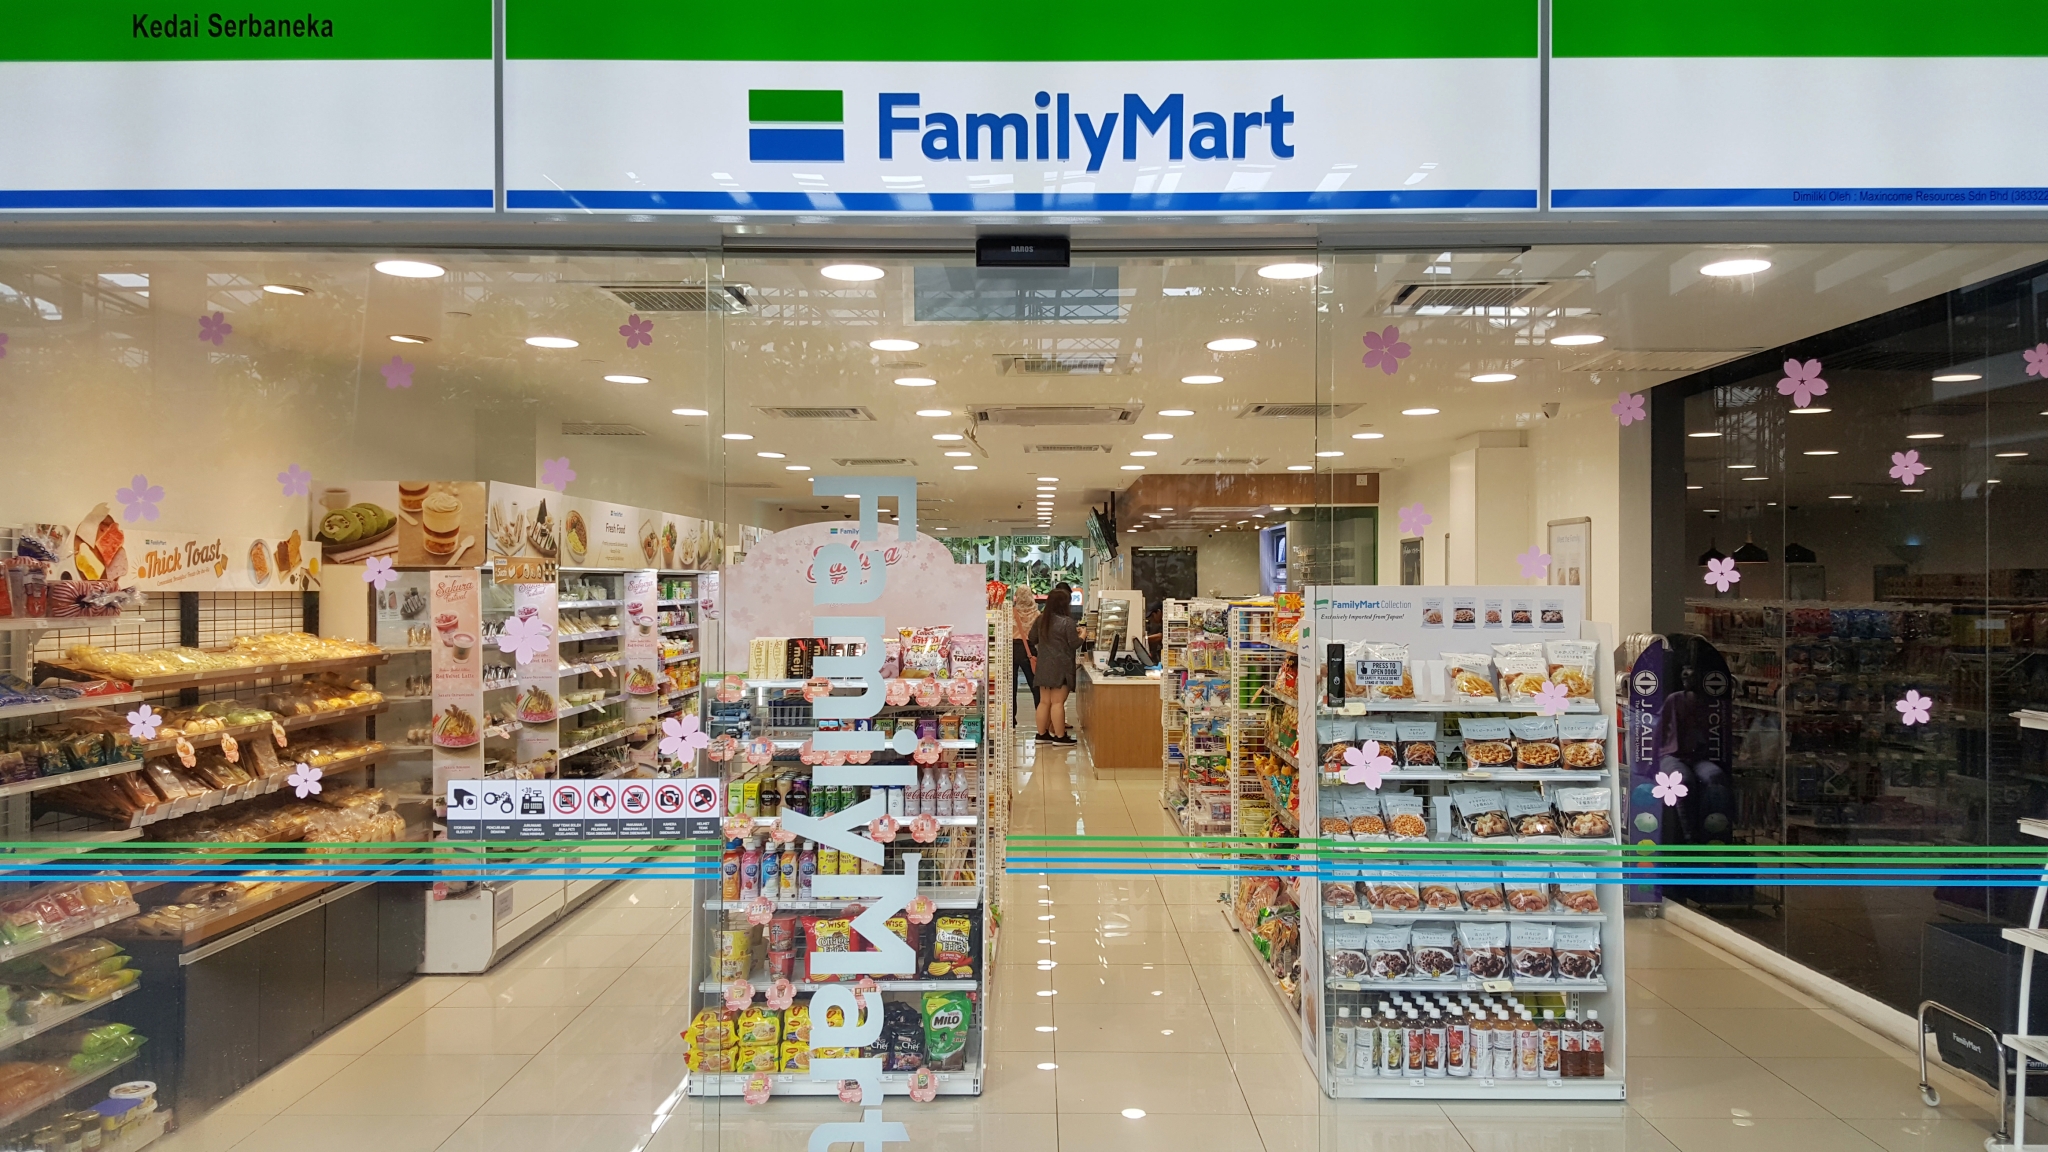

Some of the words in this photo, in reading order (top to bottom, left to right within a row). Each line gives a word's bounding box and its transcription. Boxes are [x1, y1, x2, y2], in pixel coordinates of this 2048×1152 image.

[132, 13, 199, 38] Kedai
[207, 13, 334, 38] Serbaneka
[878, 90, 1295, 172] FamilyMart
[1793, 190, 1826, 202] Dimiliki
[1829, 190, 1850, 202] Oleh
[1859, 190, 1913, 202] Maxincome
[1916, 190, 1965, 202] Resources
[1968, 190, 1986, 202] Sdn
[1990, 190, 2008, 201] Bhd
[1010, 245, 1034, 253] BAROS
[605, 522, 616, 533] Fresh
[616, 523, 626, 534] Food
[1014, 536, 1041, 545] KELUAR
[145, 546, 182, 578] Thick
[184, 538, 221, 568] Toast
[435, 579, 475, 598] Sakura
[628, 579, 654, 592] Sakura
[1332, 600, 1380, 610] FamilyMart
[1380, 600, 1412, 609] Collection
[1348, 613, 1373, 621] Imported
[790, 646, 804, 676] meiji
[1641, 699, 1653, 761] J.CALLI
[781, 475, 921, 1152] FamilyMart
[816, 936, 850, 948] Cottage
[933, 1015, 960, 1026] MILO
[871, 1041, 889, 1051] Chef
[901, 1041, 920, 1052] Chef
[1952, 1032, 1982, 1054] FamilyMart
